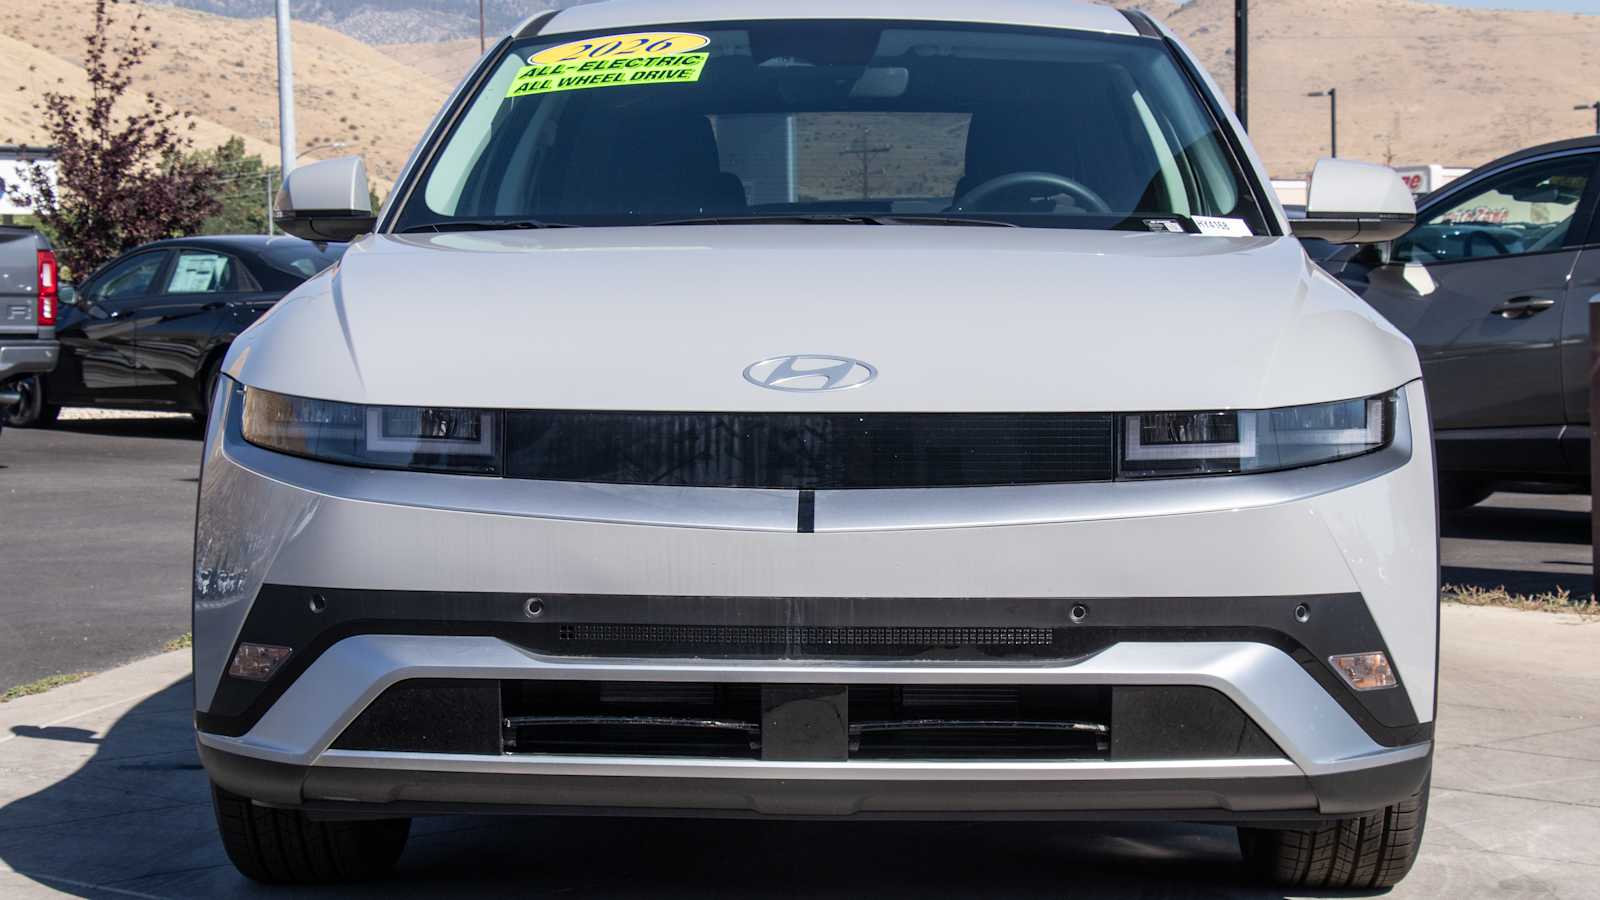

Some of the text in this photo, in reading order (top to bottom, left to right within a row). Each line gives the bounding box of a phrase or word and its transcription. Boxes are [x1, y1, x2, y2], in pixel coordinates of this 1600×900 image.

[558, 35, 682, 62] 2026
[518, 55, 704, 80] ALL-ELECTRIC
[513, 68, 693, 94] ALL WHEEL DRIVE
